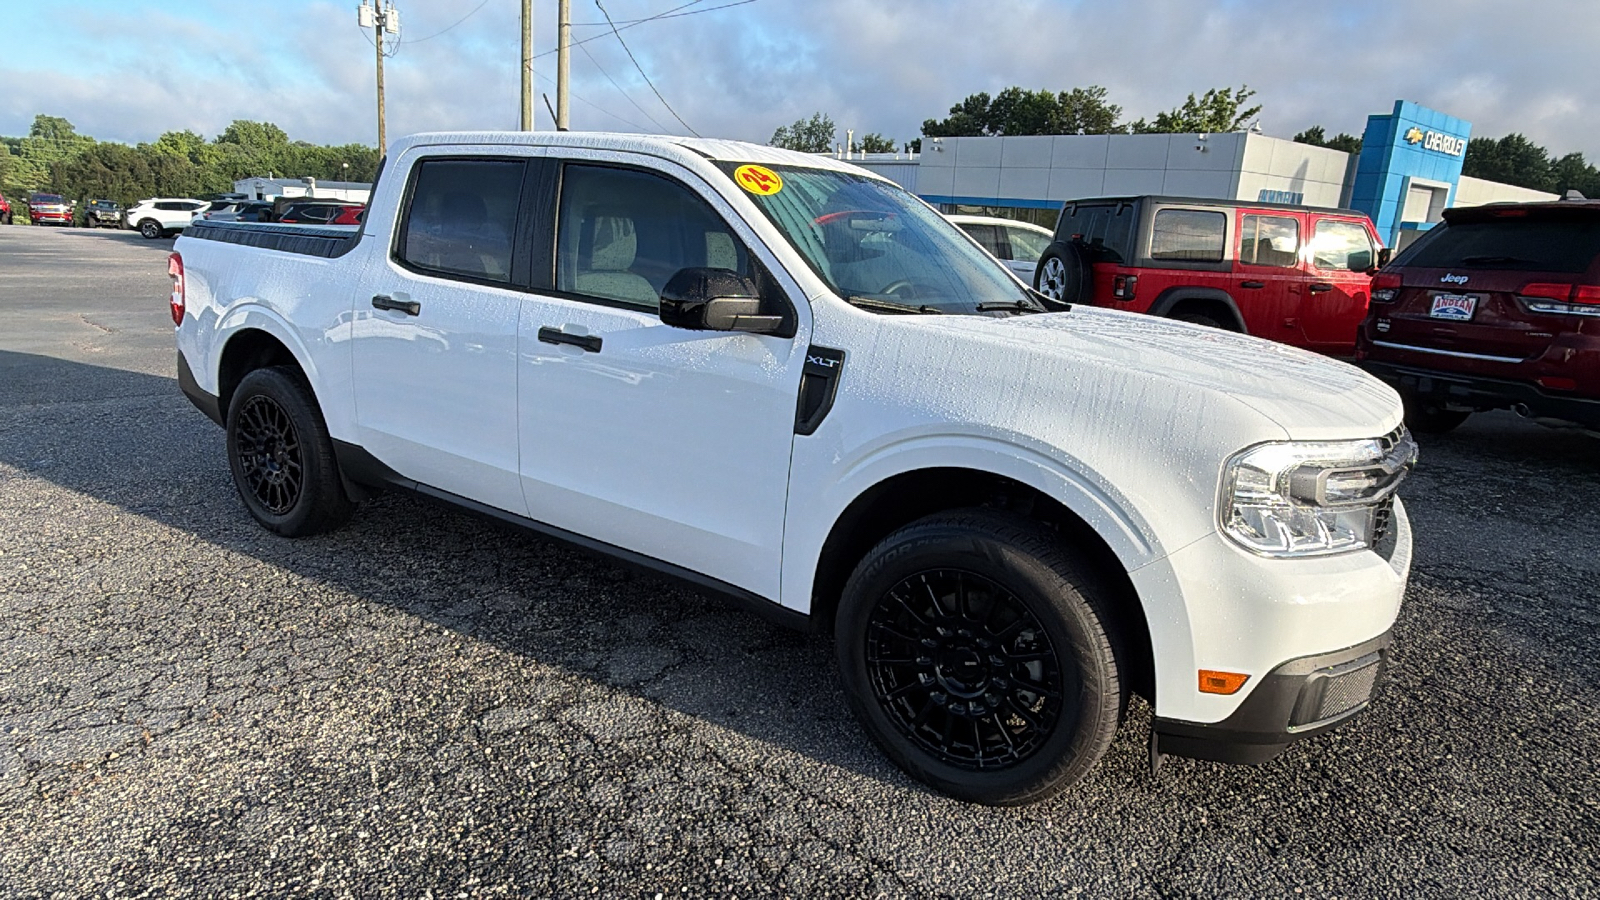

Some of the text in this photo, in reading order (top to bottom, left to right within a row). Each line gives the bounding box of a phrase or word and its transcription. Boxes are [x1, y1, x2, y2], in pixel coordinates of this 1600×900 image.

[1424, 130, 1466, 157] CHEVROLET
[741, 167, 777, 192] 24
[1440, 272, 1469, 286] Jeep
[1434, 298, 1474, 313] ANDEAN
[806, 354, 840, 368] XLT
